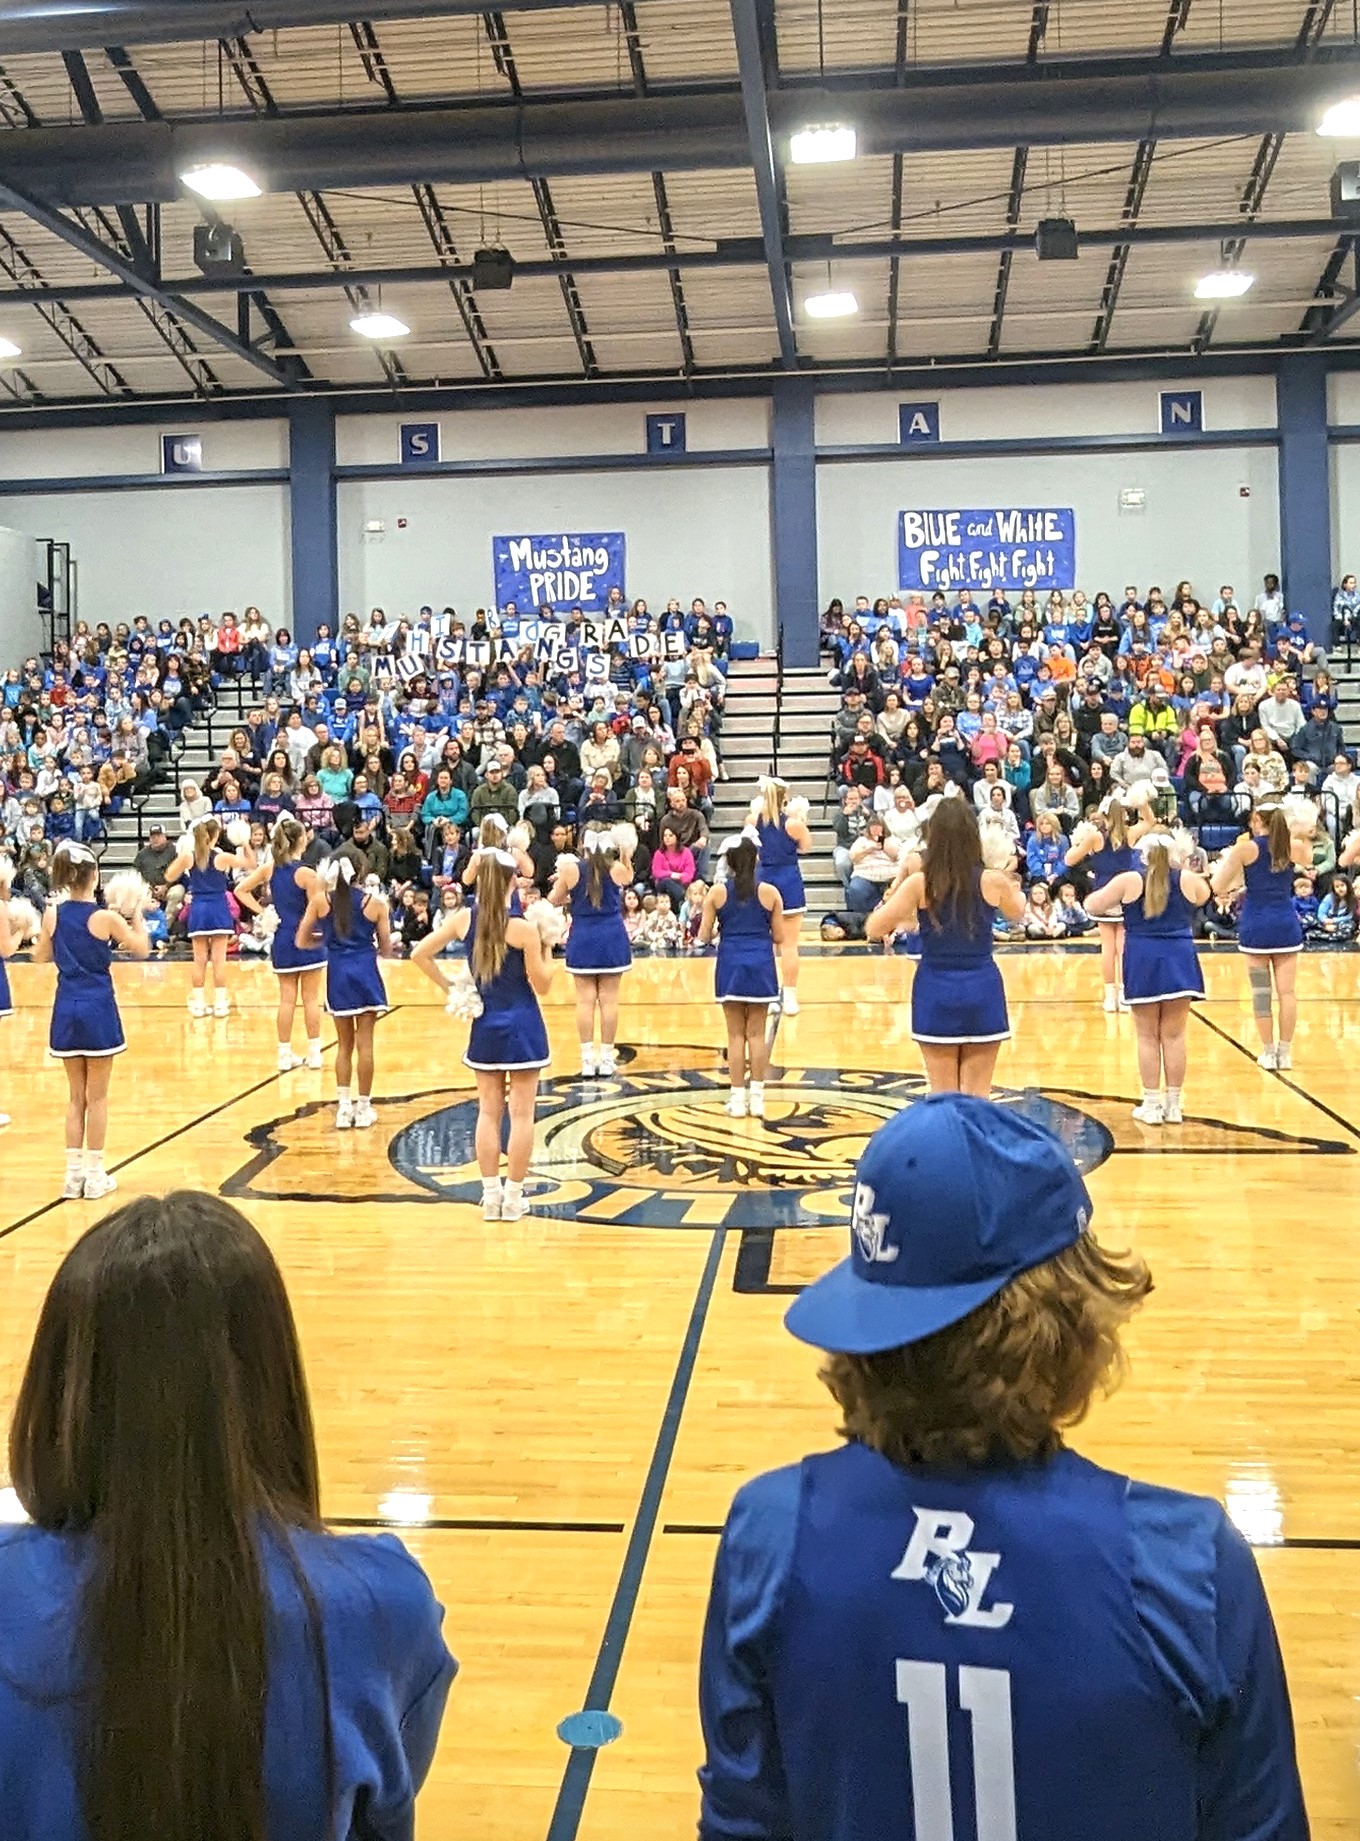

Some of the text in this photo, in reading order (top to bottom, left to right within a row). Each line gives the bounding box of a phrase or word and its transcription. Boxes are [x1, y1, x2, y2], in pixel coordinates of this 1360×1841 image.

[412, 433, 429, 455] S
[657, 423, 676, 444] T
[909, 412, 930, 434] A
[1171, 402, 1191, 423] N
[967, 519, 993, 536] and
[509, 535, 609, 575] Mustang
[1012, 549, 1055, 587] Fight
[530, 571, 596, 606] PRIDE
[895, 1658, 1018, 1841] 11
